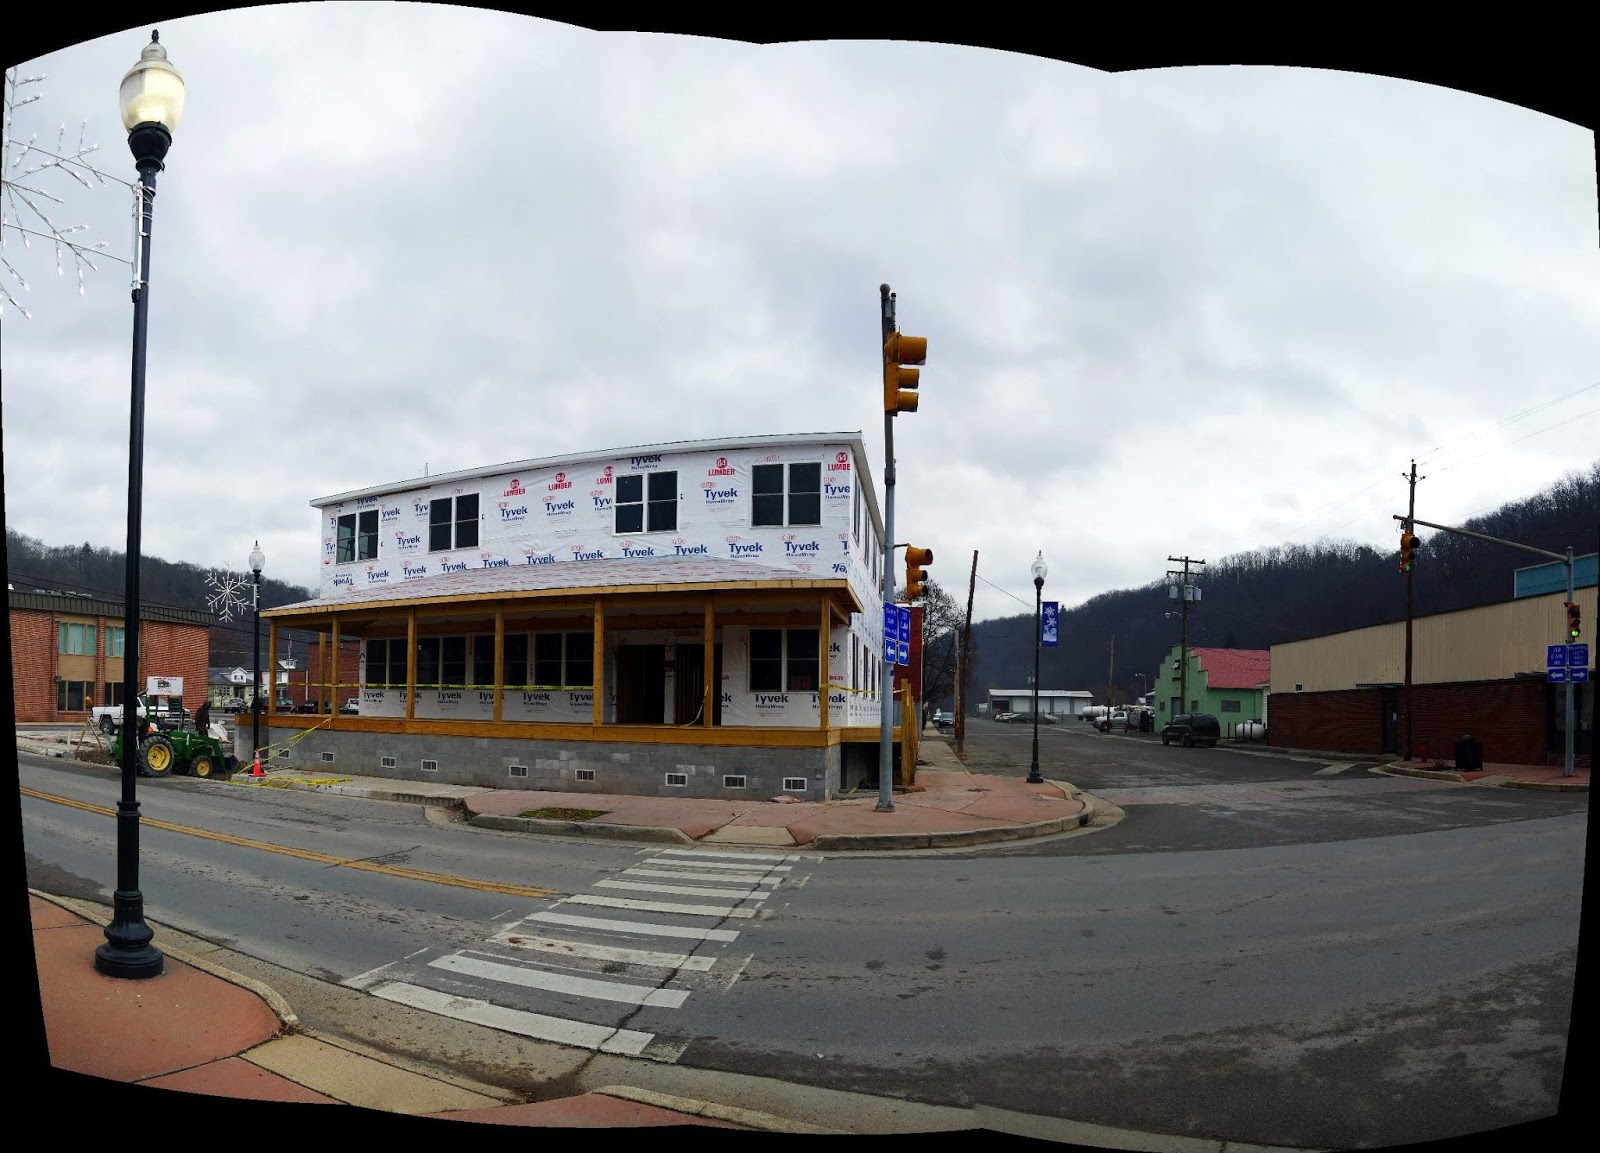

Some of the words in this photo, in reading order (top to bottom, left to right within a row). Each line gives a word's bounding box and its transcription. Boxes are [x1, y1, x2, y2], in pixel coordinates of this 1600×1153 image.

[549, 482, 572, 490] LUMBER
[504, 488, 525, 497] LUMBER
[704, 488, 738, 500] Tyvek
[545, 500, 574, 512] Tyvek
[501, 506, 528, 518] Tyvek
[397, 535, 420, 546] Tyvek
[622, 547, 654, 557] Tyvek
[674, 544, 708, 556] Tyvek
[729, 542, 763, 554] Tyvek
[784, 541, 820, 553] Tyvek
[526, 554, 555, 564] Tyvek
[573, 550, 603, 560] Tyvek
[442, 562, 466, 572] Tyvek
[482, 558, 509, 568] Tyvek
[367, 570, 389, 580] Tyvek
[403, 566, 426, 576] Tyvek
[363, 691, 384, 699] Tyvek
[438, 692, 462, 700] Tyvek
[523, 692, 550, 701] Tyvek
[755, 694, 788, 704] Tyvek
